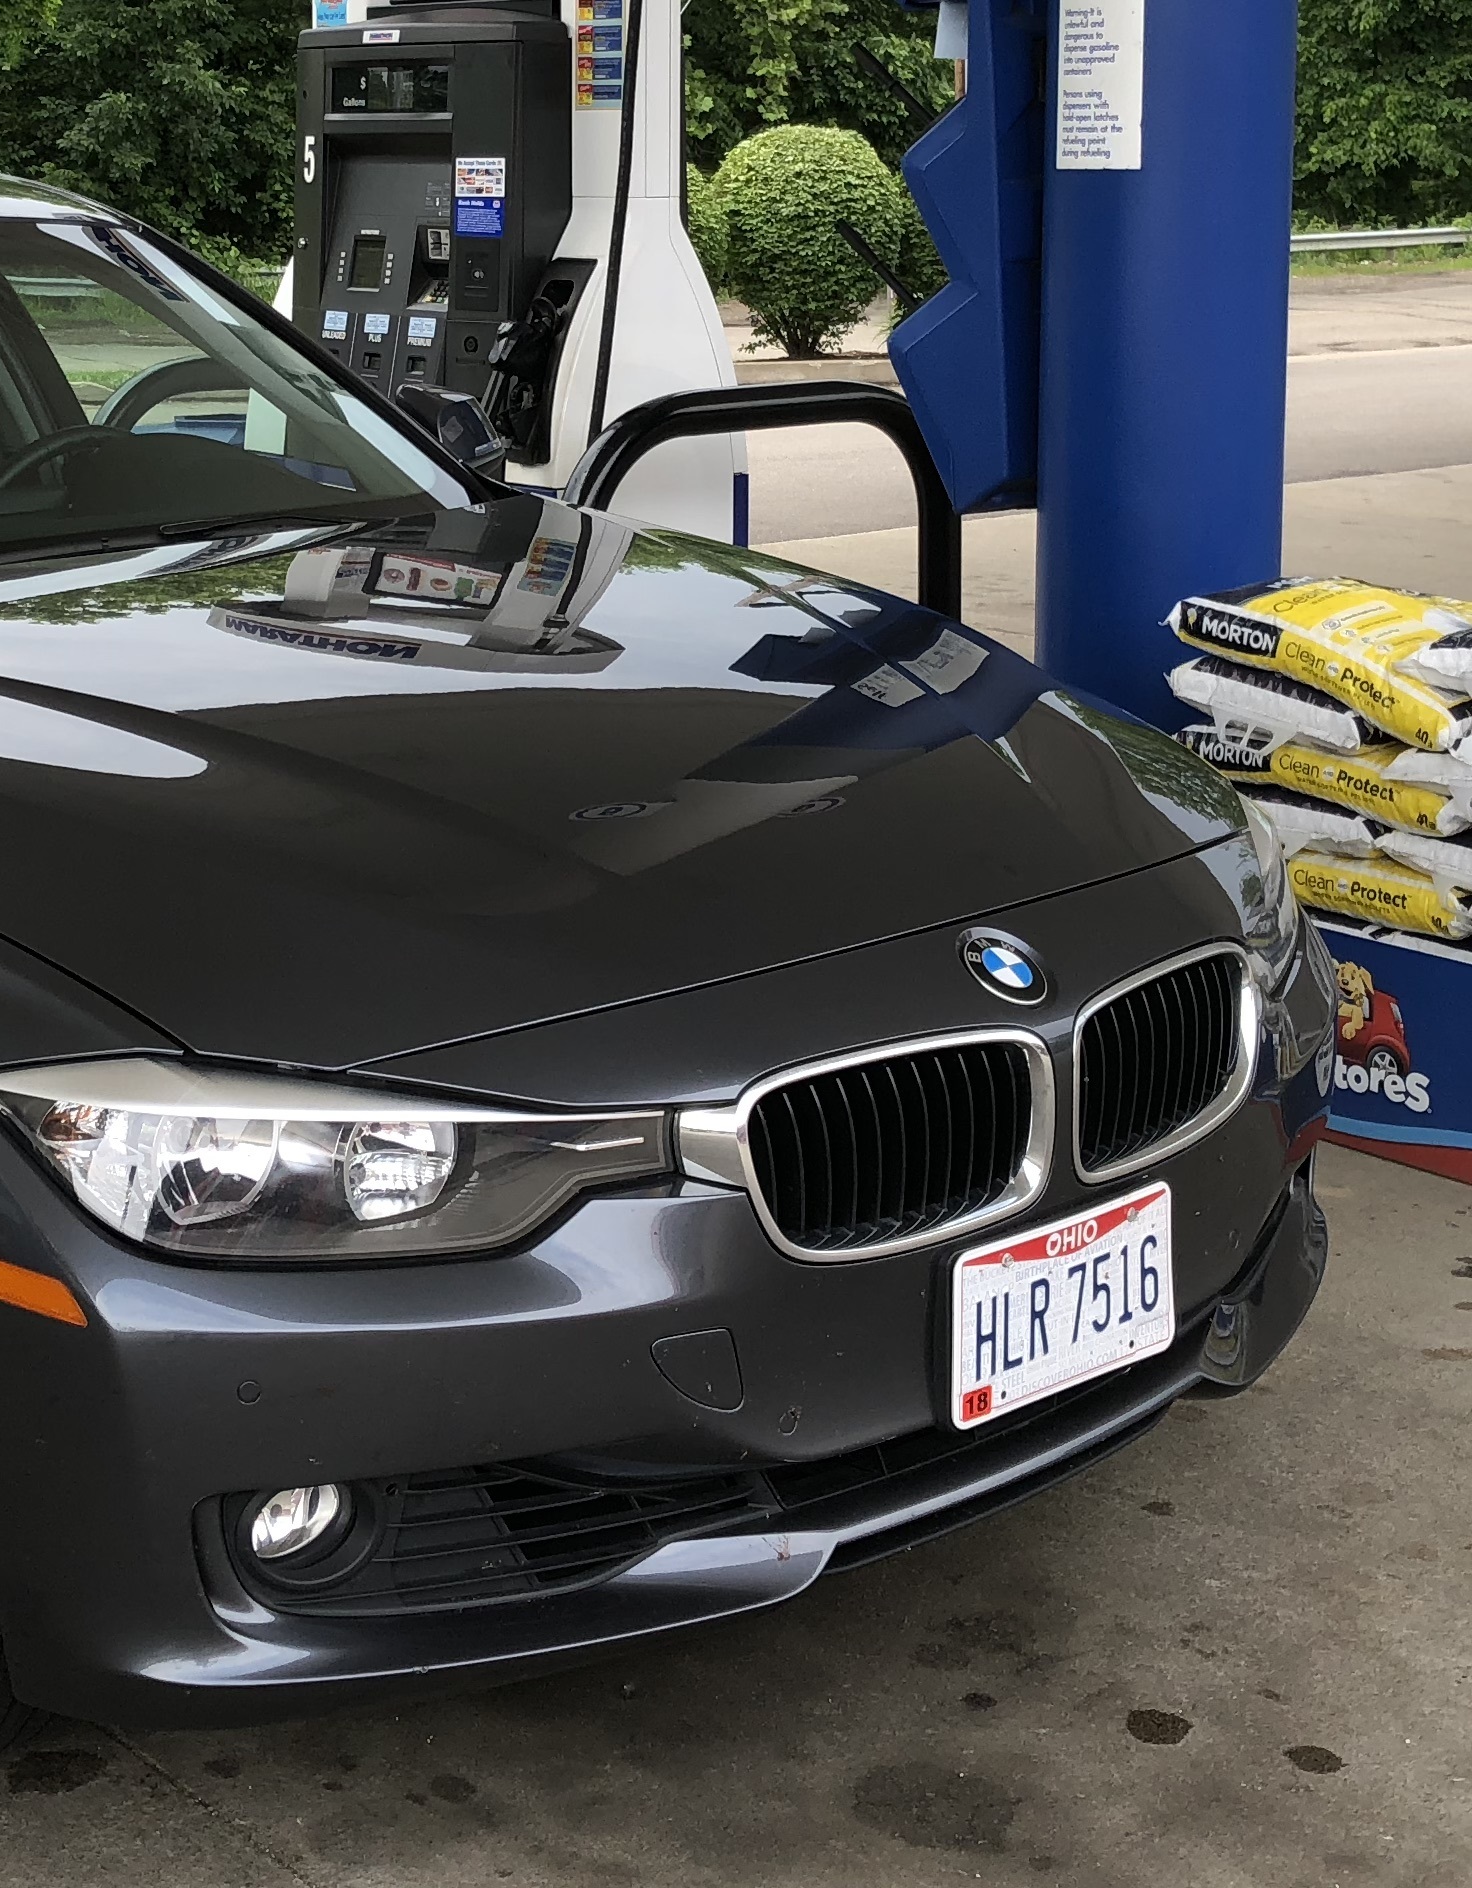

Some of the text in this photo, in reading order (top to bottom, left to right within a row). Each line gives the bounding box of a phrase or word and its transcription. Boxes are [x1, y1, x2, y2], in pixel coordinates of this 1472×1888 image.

[1096, 7, 1103, 16] is
[1090, 18, 1105, 28] and
[1064, 31, 1104, 43] dangerous to
[1063, 41, 1120, 54] dispense gasoline
[1074, 53, 1116, 66] unapproved
[1063, 66, 1093, 76] containers
[1063, 88, 1103, 100] Persons using
[1062, 100, 1110, 113] dispensers with
[1093, 111, 1120, 121] latches
[1075, 124, 1099, 133] remain
[1100, 125, 1109, 133] at
[1110, 123, 1124, 133] the
[1087, 136, 1107, 149] point
[303, 135, 316, 184] 5
[1061, 148, 1080, 160] during
[367, 333, 382, 343] PLUS
[1201, 614, 1277, 654] MORTON
[1285, 641, 1326, 671] Clean
[1340, 667, 1396, 709] Protect
[1199, 740, 1265, 769] MORTON
[1279, 752, 1320, 779] Clean
[1337, 768, 1395, 803] Protect
[1293, 868, 1334, 892] Clean
[1350, 881, 1408, 910] Protect
[967, 937, 1016, 964] BMW
[1045, 1219, 1098, 1257] OHIO
[975, 1234, 1159, 1383] HLR 7516
[965, 1391, 989, 1416] 18
